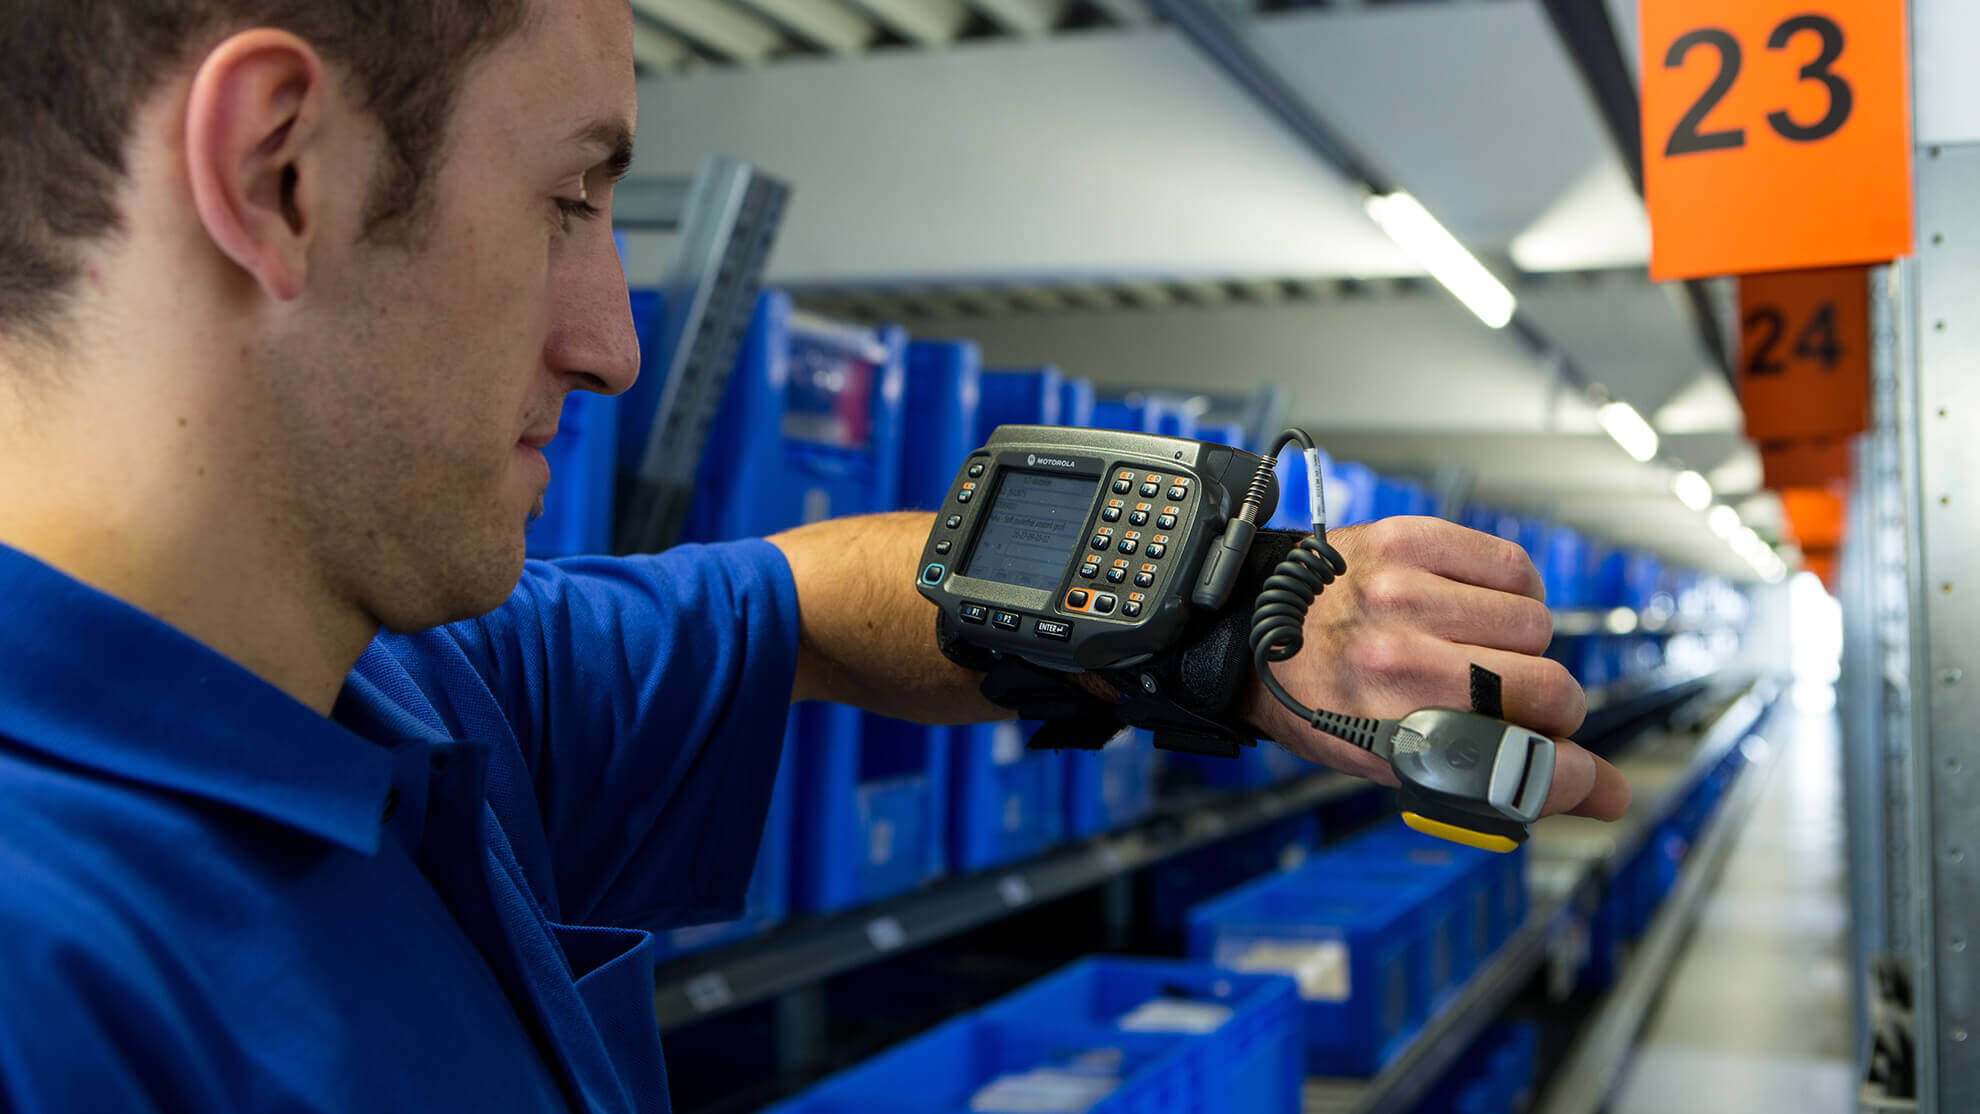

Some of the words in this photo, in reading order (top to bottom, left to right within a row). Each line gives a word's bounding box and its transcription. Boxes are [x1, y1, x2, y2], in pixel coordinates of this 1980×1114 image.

[1664, 14, 1853, 157] 23
[1744, 303, 1843, 376] 24
[1036, 457, 1075, 468] MOTOROLA
[1003, 614, 1012, 624] P2
[1038, 622, 1057, 633] ENTER
